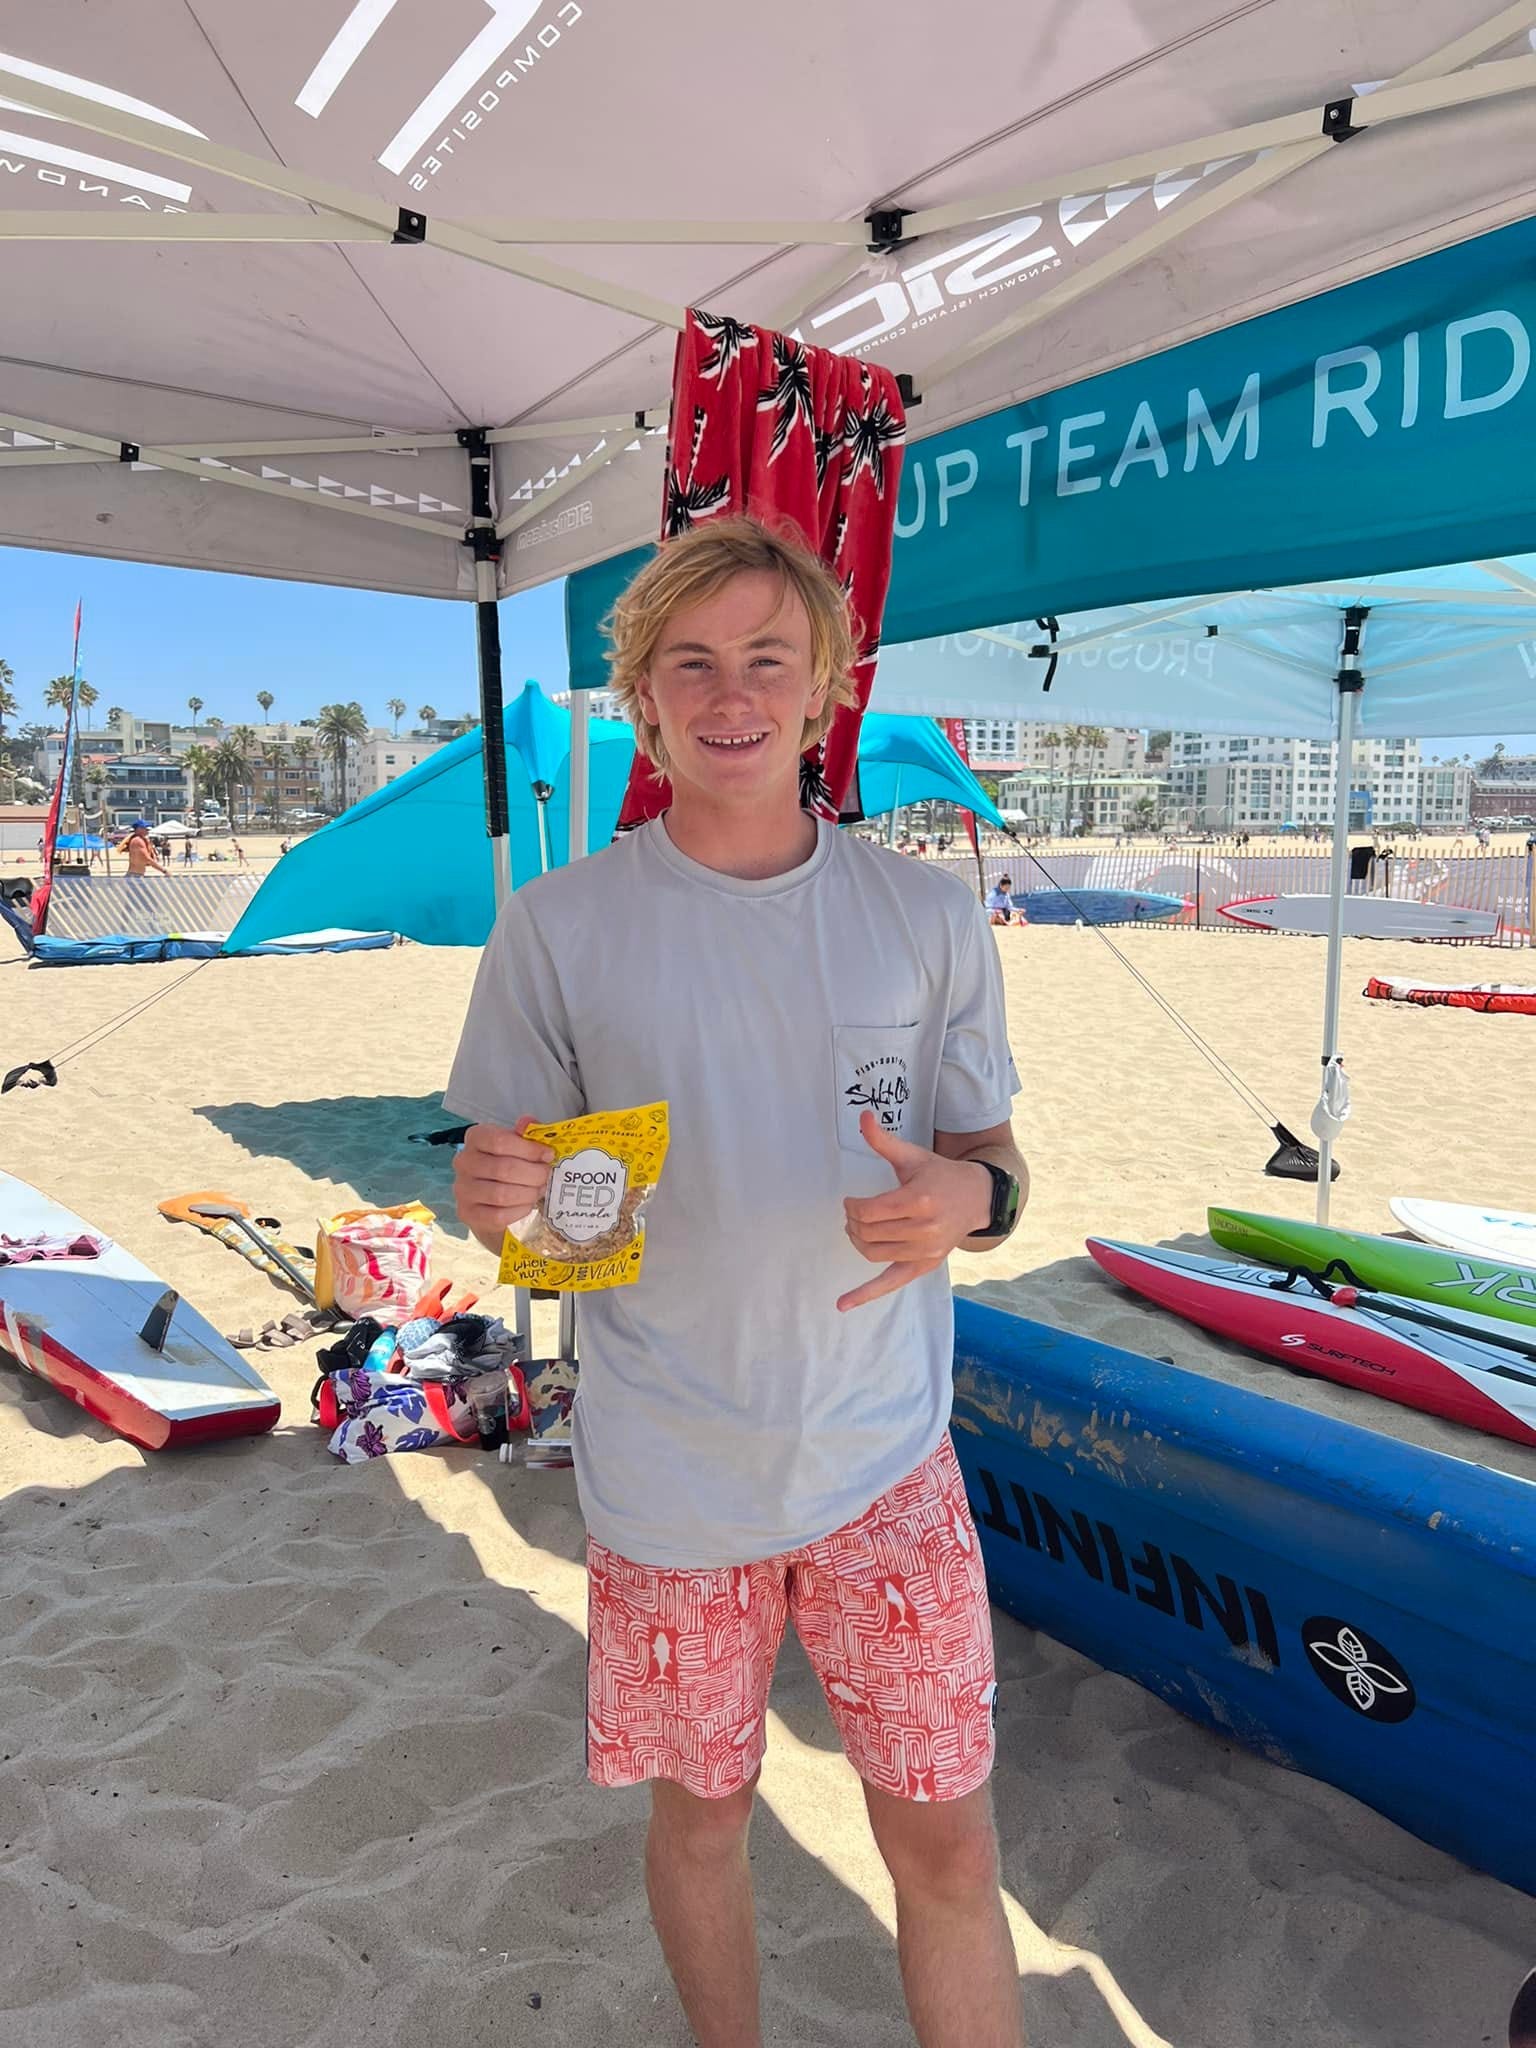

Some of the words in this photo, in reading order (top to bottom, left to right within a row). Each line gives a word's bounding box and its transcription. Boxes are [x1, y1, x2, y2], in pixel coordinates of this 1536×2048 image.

[1006, 372, 1260, 507] TEAM
[1312, 310, 1531, 448] RID
[563, 1171, 617, 1185] SPOON
[559, 1183, 615, 1207] FED
[555, 1208, 611, 1220] granola
[1307, 1343, 1397, 1376] SURFTECH
[970, 1468, 1281, 1668] INFINIT
